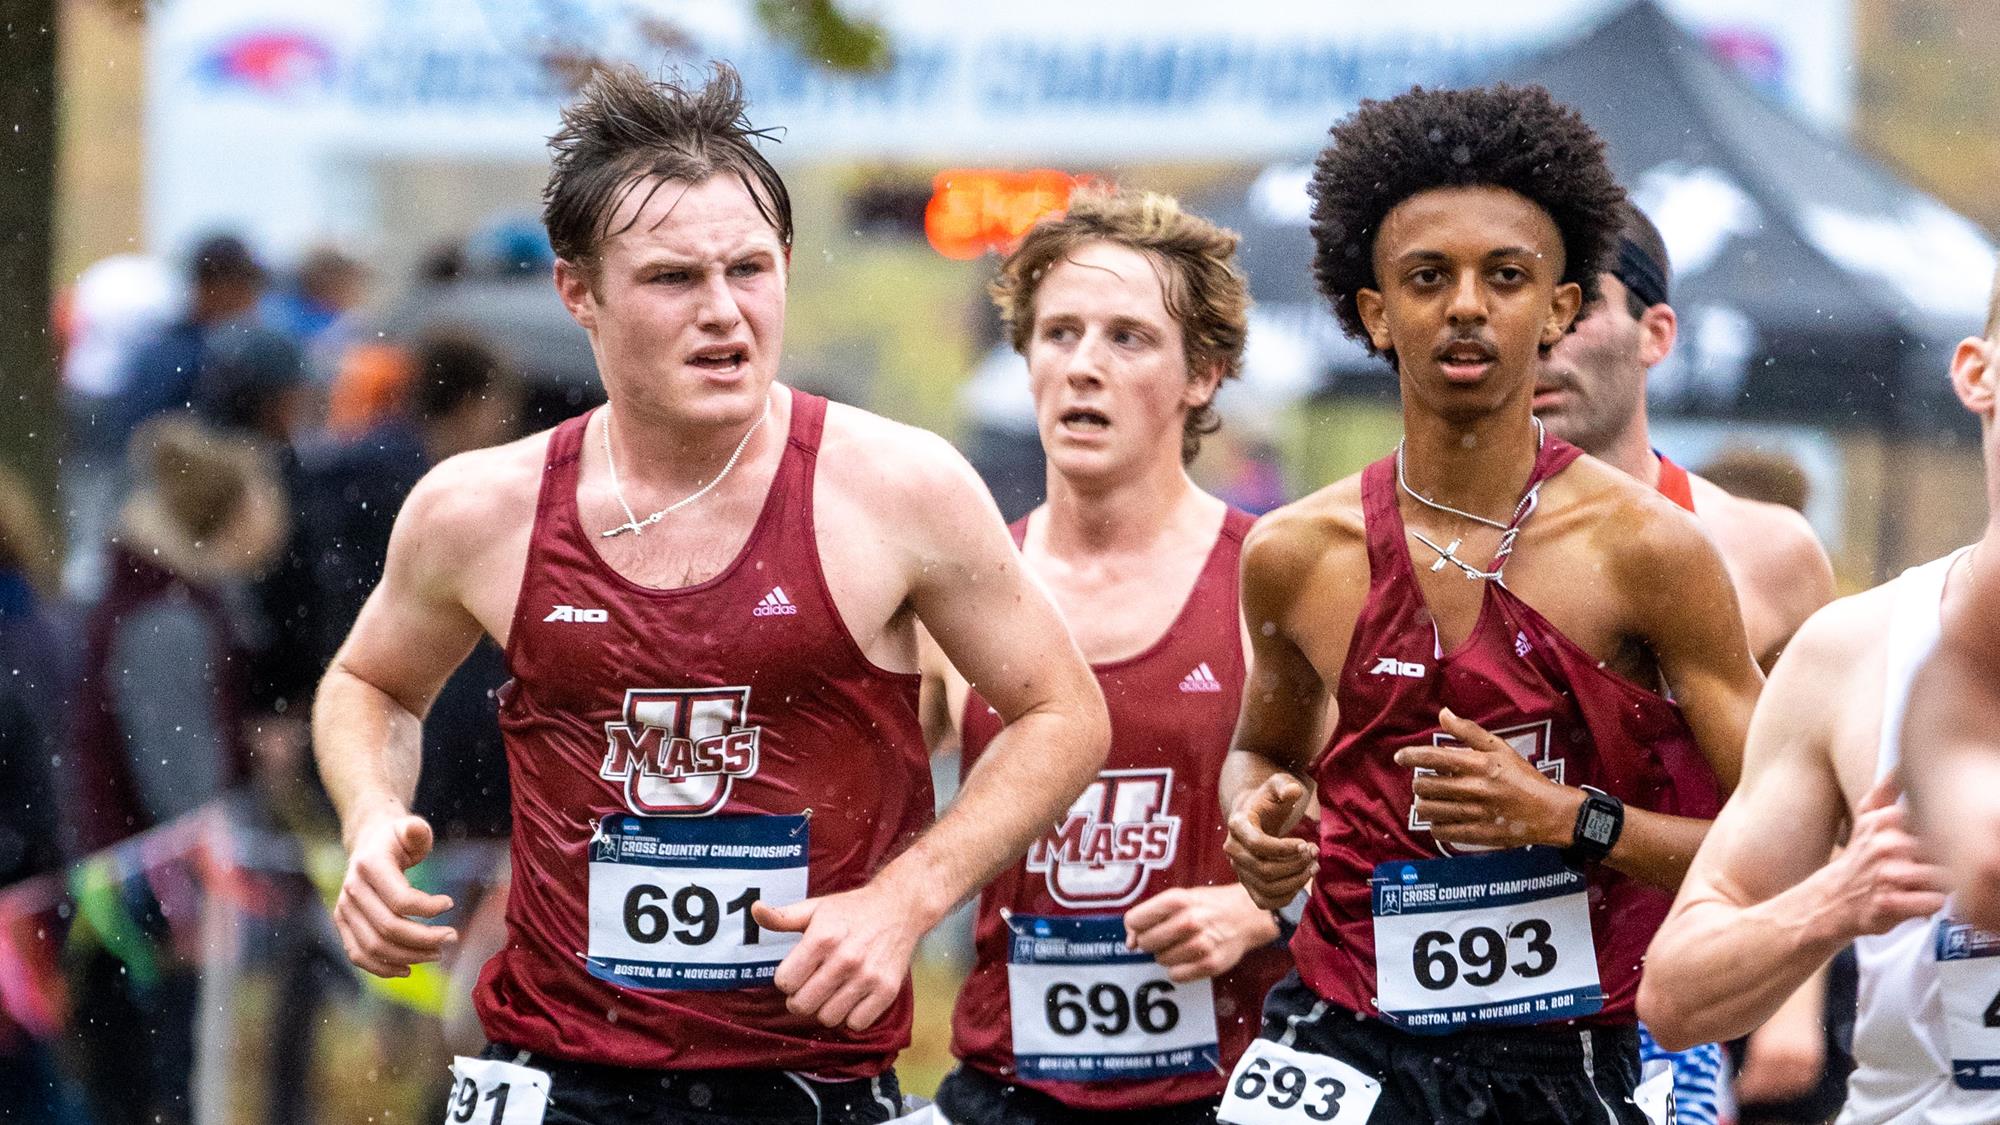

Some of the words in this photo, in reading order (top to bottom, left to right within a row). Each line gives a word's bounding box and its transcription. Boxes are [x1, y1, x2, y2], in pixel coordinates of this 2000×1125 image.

[542, 605, 608, 622] A10
[753, 603, 797, 617] adidas
[1370, 657, 1425, 678] A10
[622, 686, 751, 817] U
[621, 841, 656, 855] CROSS
[658, 842, 709, 857] COUNTRY
[710, 844, 802, 859] CHAMPIONSHIPS
[1402, 889, 1436, 903] CROSS
[1439, 884, 1487, 901] COUNTRY
[1489, 873, 1578, 896] CHAMPIONSHIPS
[623, 884, 761, 946] 691
[1413, 919, 1557, 990] 693
[614, 963, 655, 978] BOSTON,
[657, 967, 672, 978] MA
[684, 968, 736, 979] NOVEMBER
[1046, 979, 1180, 1037] 696
[1408, 1013, 1450, 1026] BOSTON,
[1452, 1012, 1467, 1023] MA
[1479, 1003, 1531, 1020] NOVEMBER
[1551, 994, 1574, 1009] 2021
[1234, 1058, 1347, 1121] 693
